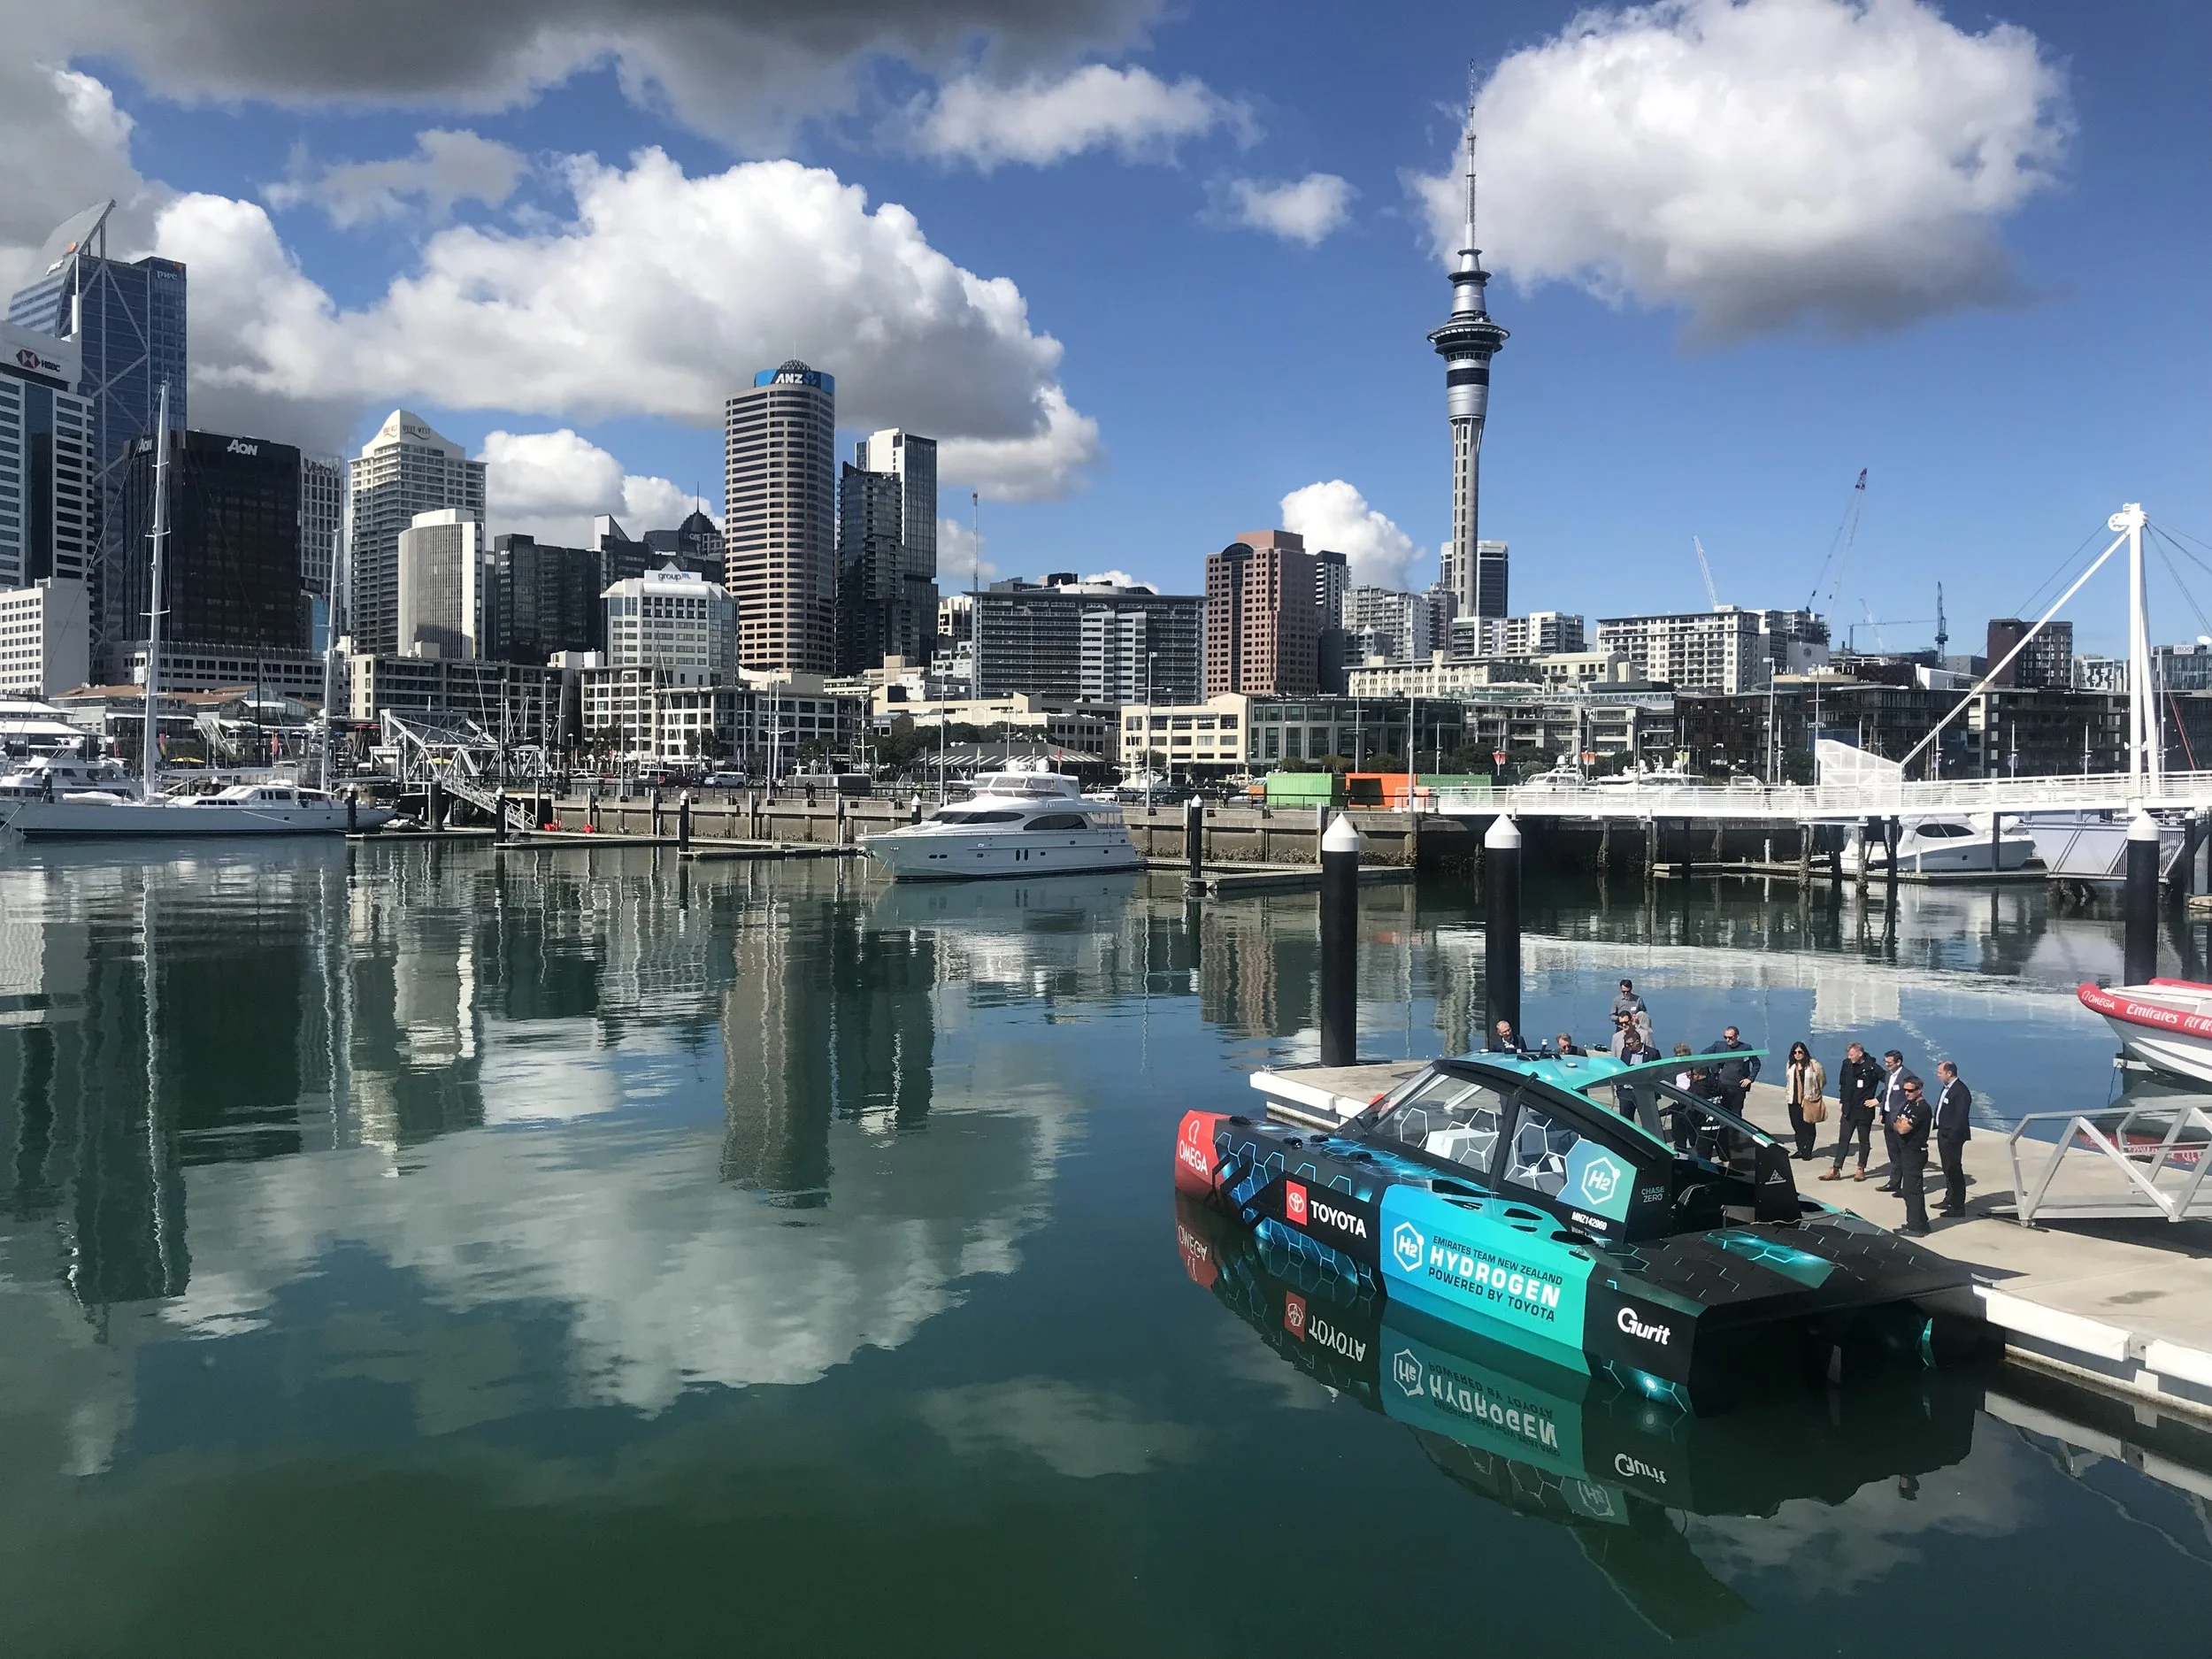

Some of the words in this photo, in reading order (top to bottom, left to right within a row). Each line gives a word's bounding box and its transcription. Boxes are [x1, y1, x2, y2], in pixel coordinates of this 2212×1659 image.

[775, 373, 803, 384] ANZ
[2088, 994, 2116, 1010] OMEGA
[2126, 1002, 2179, 1025] Emirates
[2184, 1016, 2202, 1029] FLY
[1179, 1141, 1209, 1176] OMEGA
[1587, 1170, 1611, 1192] H2
[1640, 1186, 1665, 1196] CHASE
[1643, 1193, 1663, 1203] ZERO
[1310, 1200, 1367, 1240] TOYOTA
[1398, 1234, 1418, 1258] H2
[1432, 1235, 1471, 1256] EMIRATES
[1473, 1248, 1496, 1264] TEAM
[1497, 1257, 1519, 1272] NEW
[1520, 1264, 1563, 1286] ZEALAND
[1428, 1266, 1484, 1296] POWERED
[1487, 1288, 1503, 1303] BY
[1508, 1295, 1555, 1323] TOYOTA
[1430, 1245, 1562, 1309] HYDROGEN
[1617, 1307, 1671, 1346] Gurit
